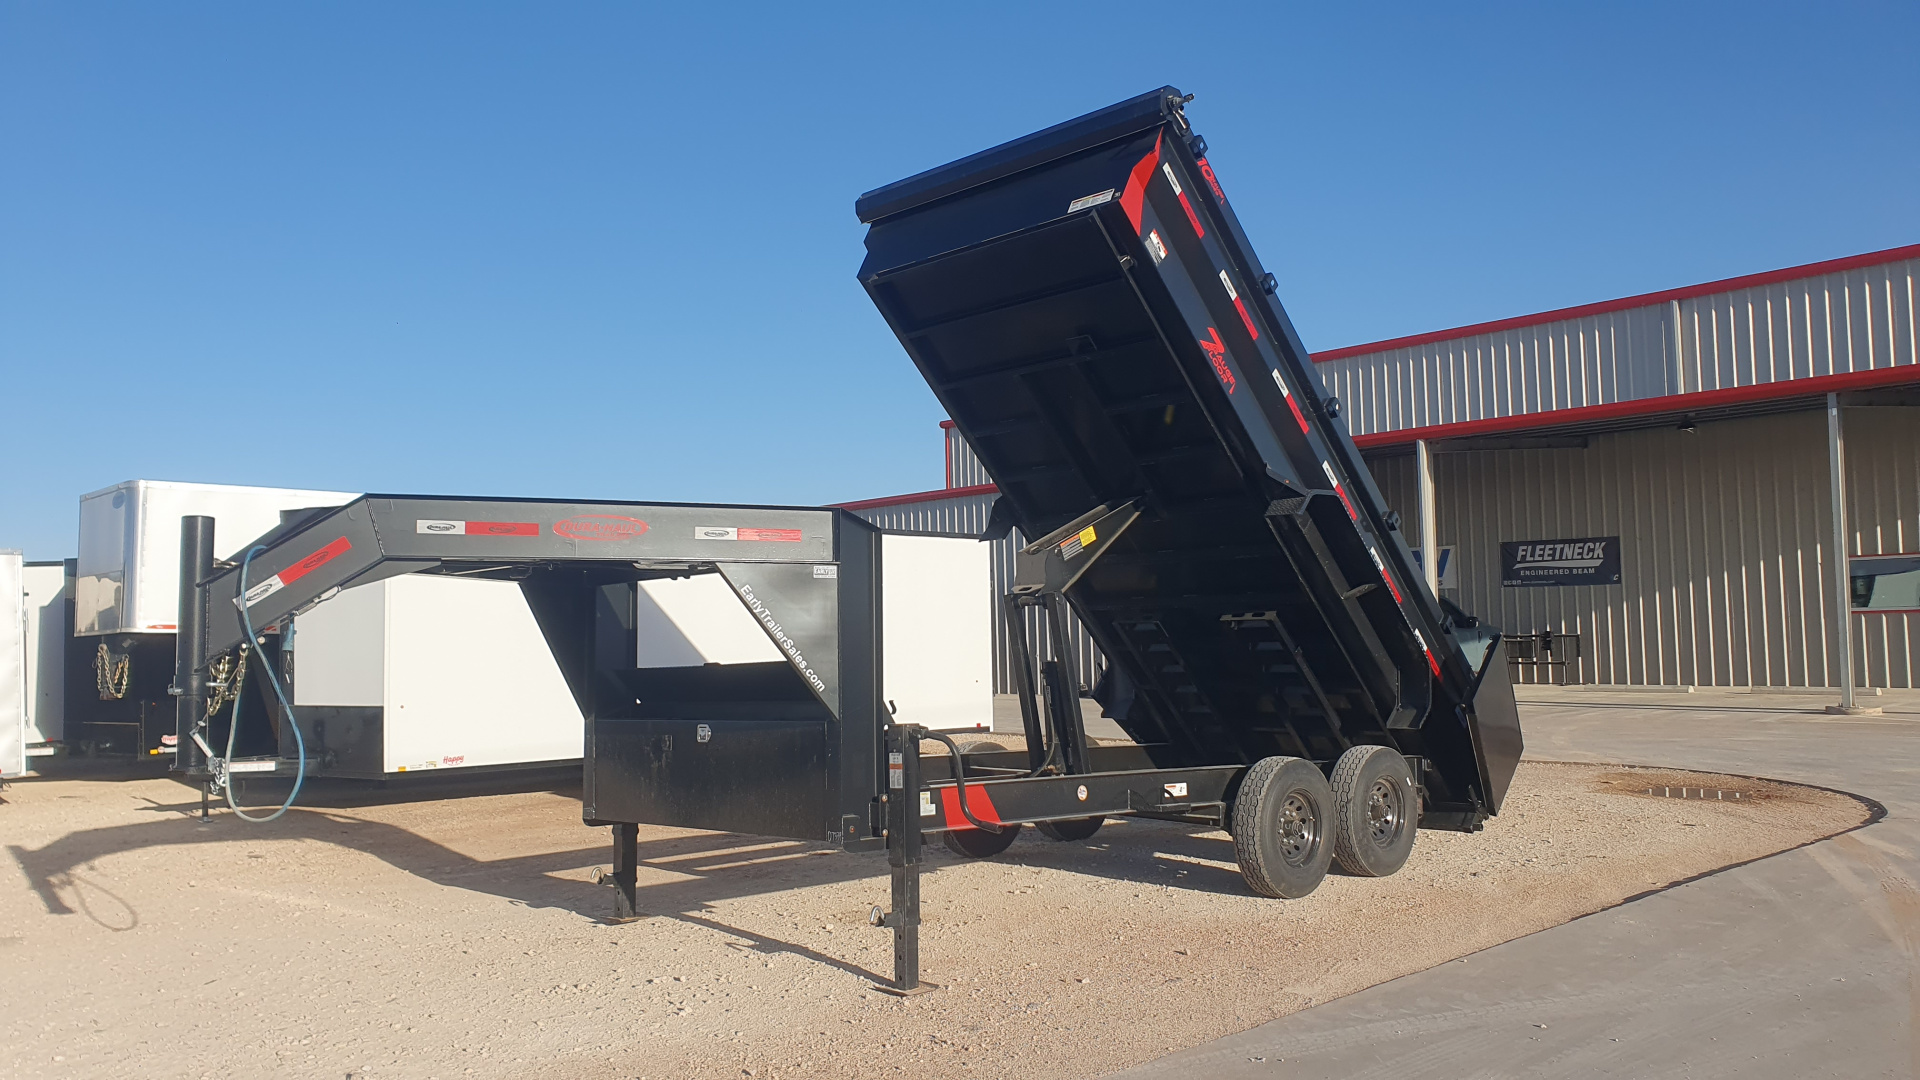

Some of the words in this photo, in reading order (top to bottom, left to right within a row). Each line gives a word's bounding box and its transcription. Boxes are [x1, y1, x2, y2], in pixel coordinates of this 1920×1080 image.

[1197, 157, 1215, 182] 10
[1200, 327, 1225, 353] 7
[563, 521, 637, 534] DURA-HAUL
[1516, 541, 1606, 561] FLEETNECK
[1572, 567, 1596, 575] BEAM
[740, 584, 826, 692] EarlyTrailerSales.com
